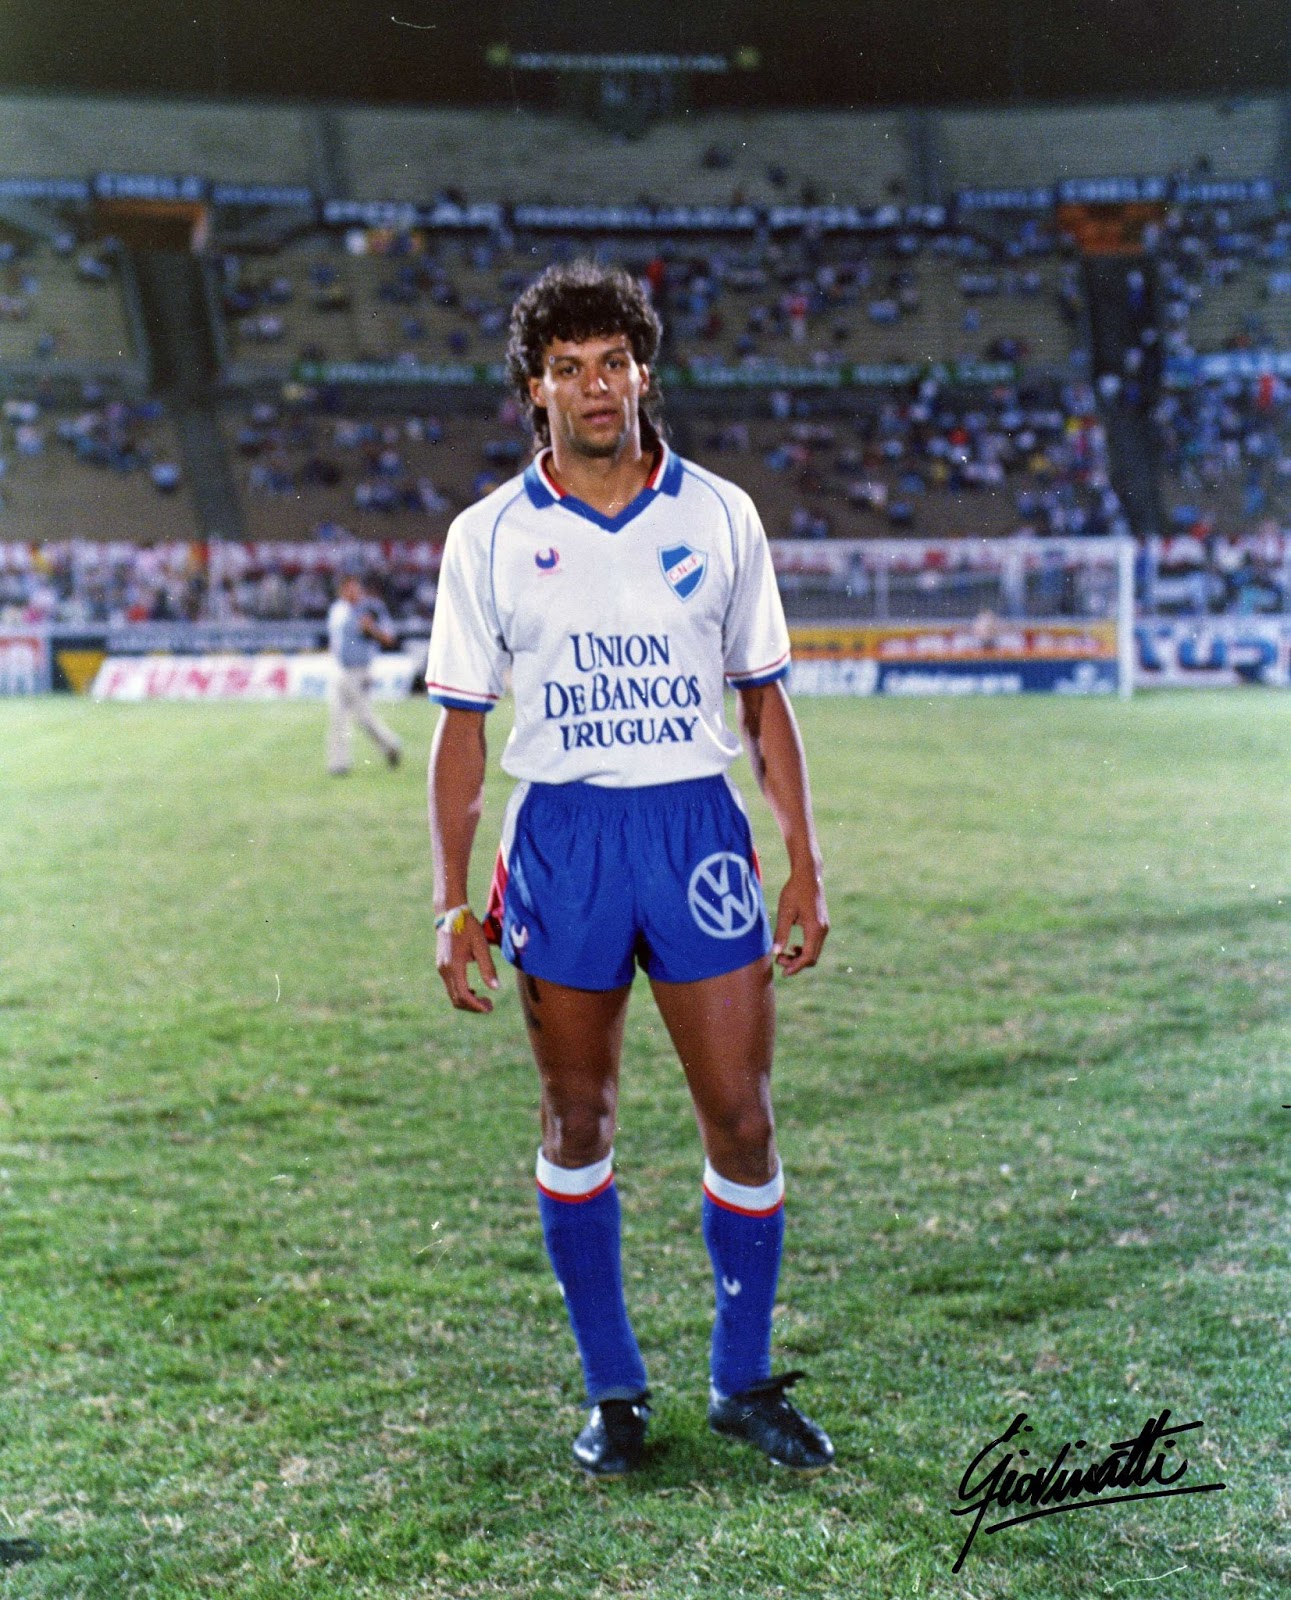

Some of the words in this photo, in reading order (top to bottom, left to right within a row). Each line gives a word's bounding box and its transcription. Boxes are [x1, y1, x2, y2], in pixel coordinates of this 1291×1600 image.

[570, 632, 670, 672] UNION
[544, 682, 586, 719] DE
[591, 673, 701, 712] BANCOS
[560, 717, 699, 751] URUGUAY
